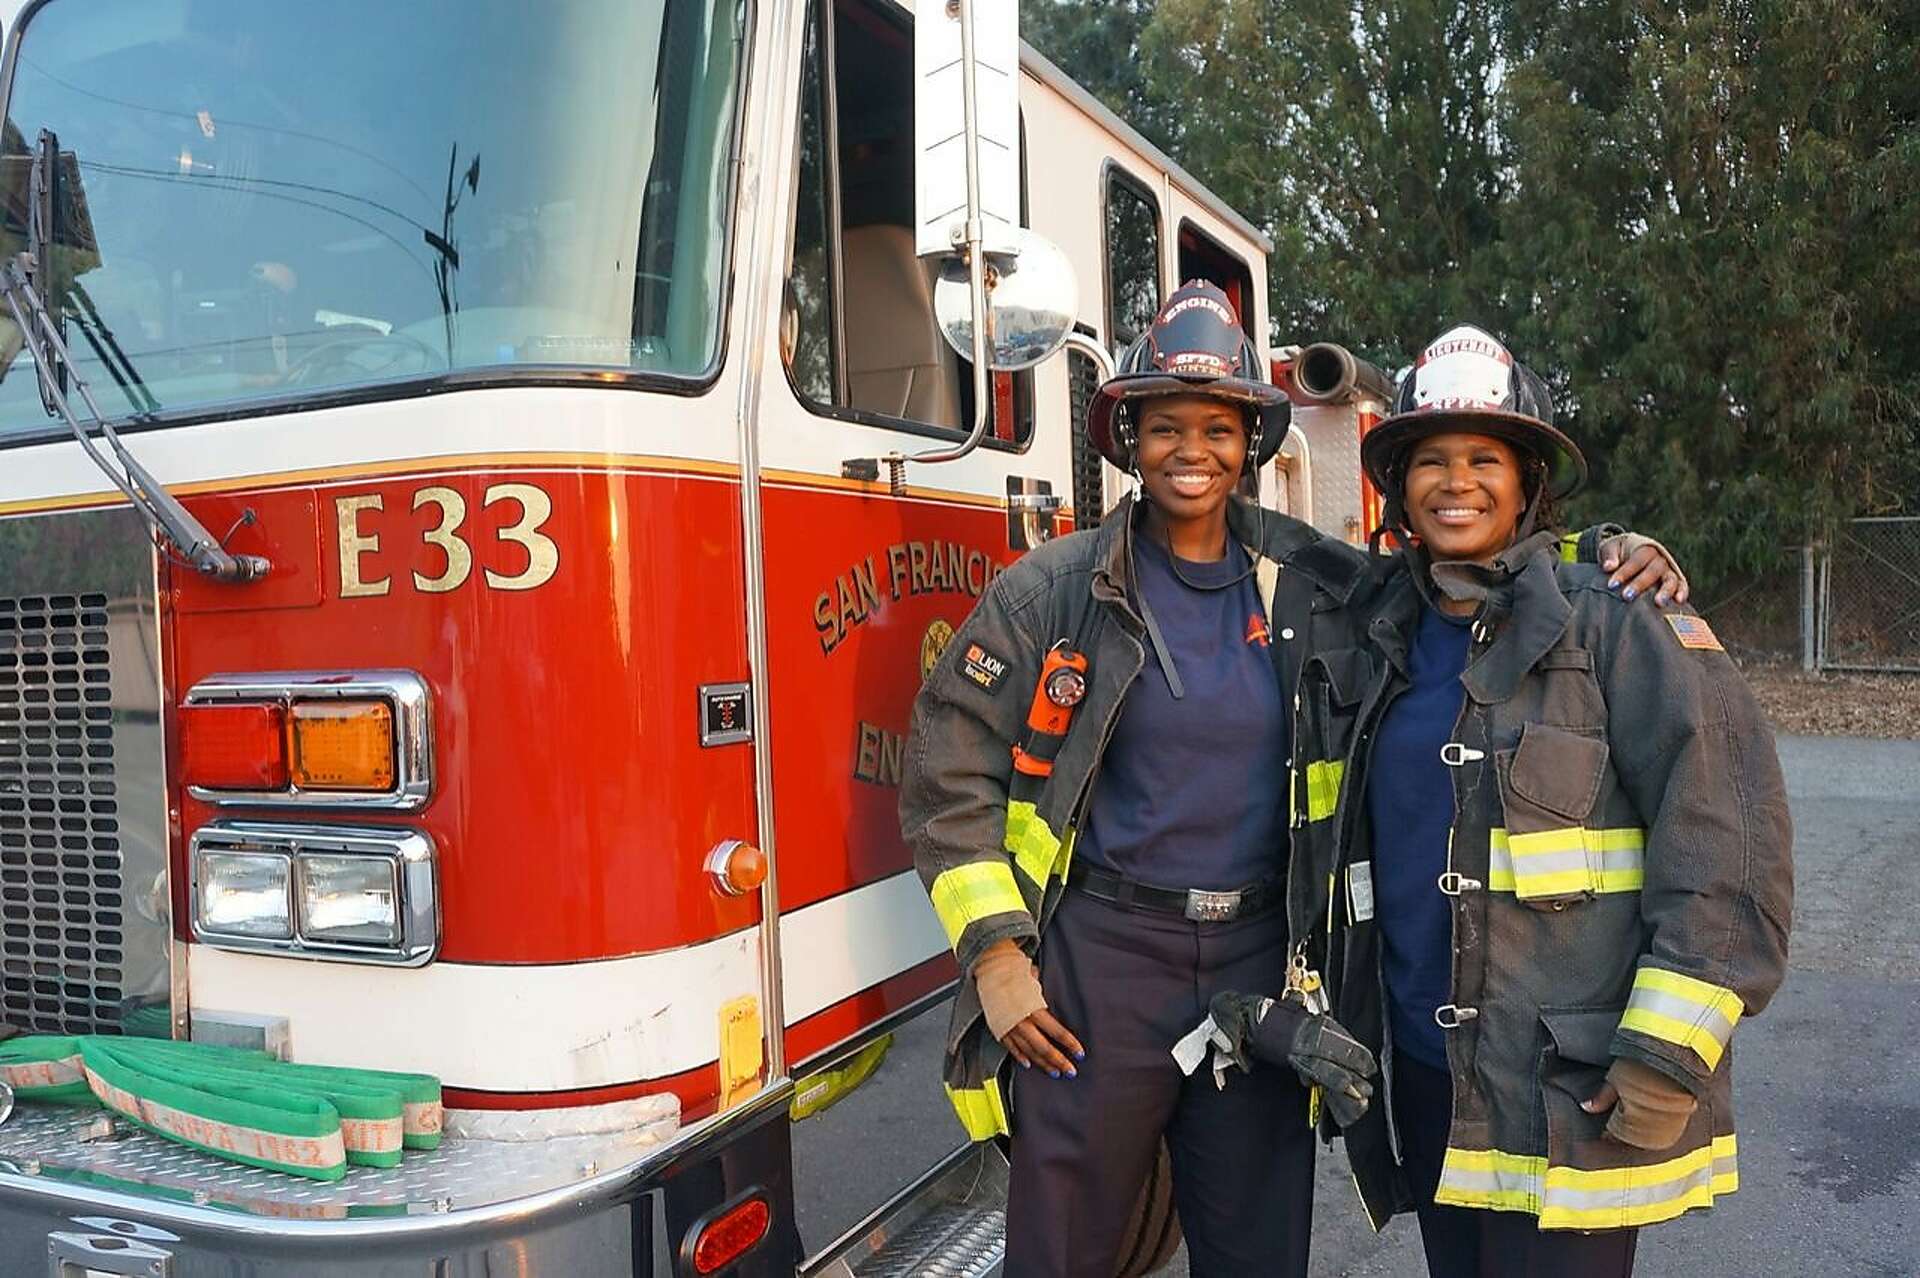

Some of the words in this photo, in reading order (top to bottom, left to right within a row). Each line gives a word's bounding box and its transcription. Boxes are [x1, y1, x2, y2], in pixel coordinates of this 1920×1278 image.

[1162, 297, 1231, 324] ENGINE
[335, 493, 391, 598] E
[411, 482, 560, 593] 33
[814, 552, 881, 658] SAN
[979, 652, 1005, 677] LION
